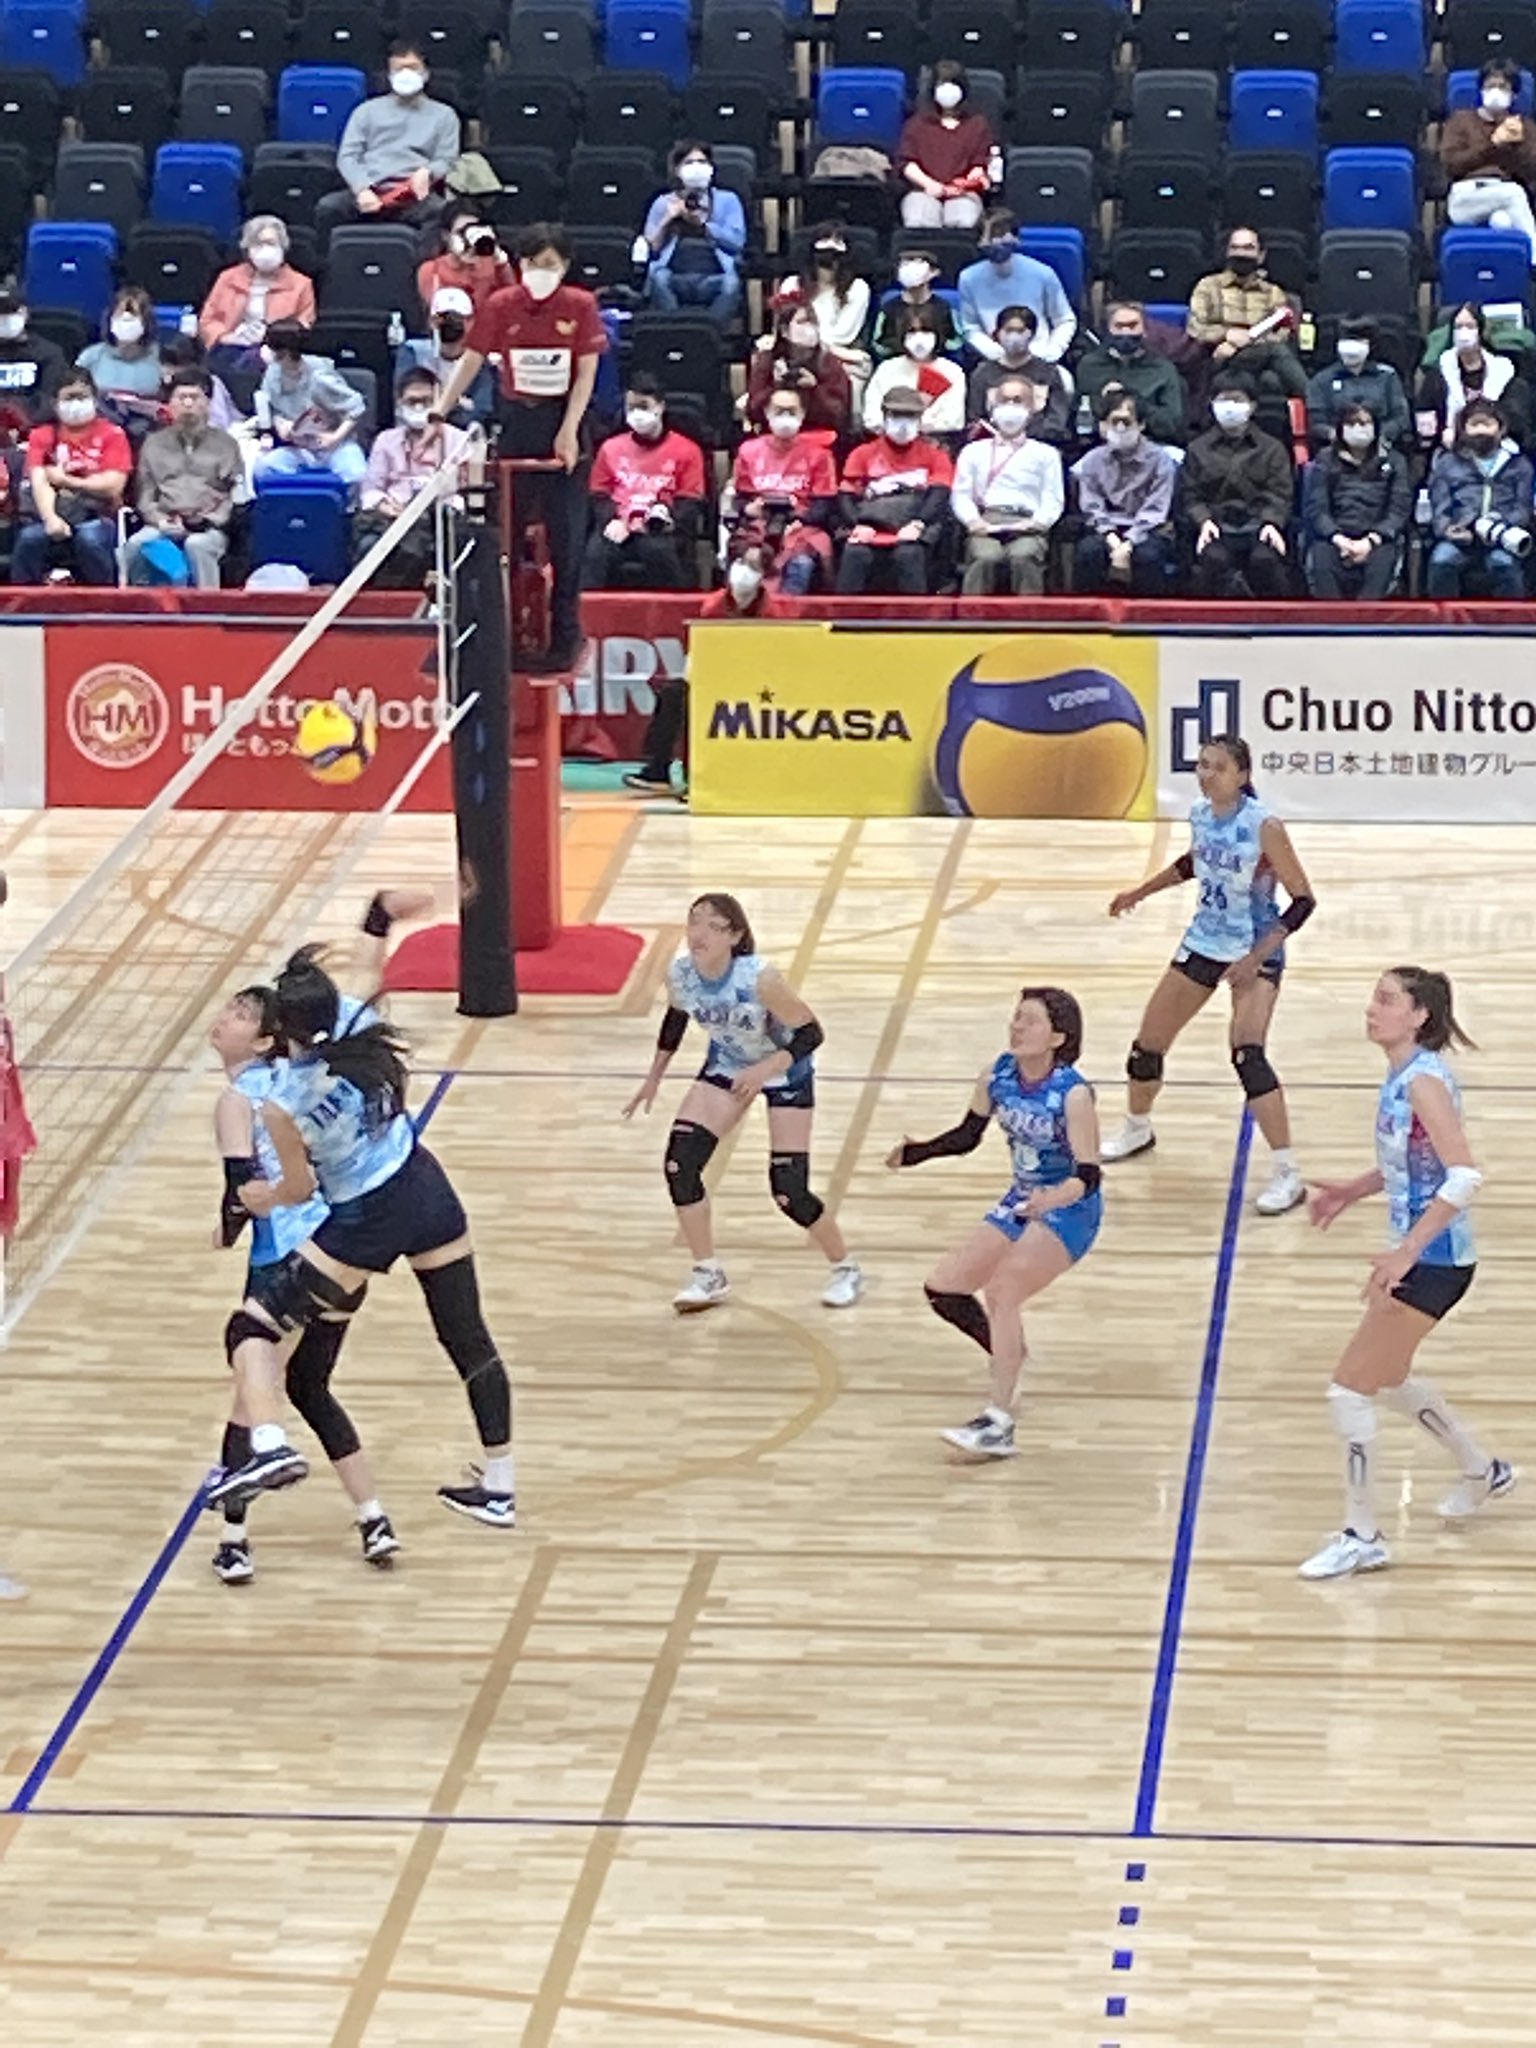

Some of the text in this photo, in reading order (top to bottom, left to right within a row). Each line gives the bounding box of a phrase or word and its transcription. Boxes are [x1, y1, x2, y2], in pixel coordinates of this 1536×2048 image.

[83, 703, 150, 734] HM
[707, 690, 911, 741] MIKASA
[1262, 687, 1536, 733] Chuo Nitto
[1201, 878, 1227, 910] 26
